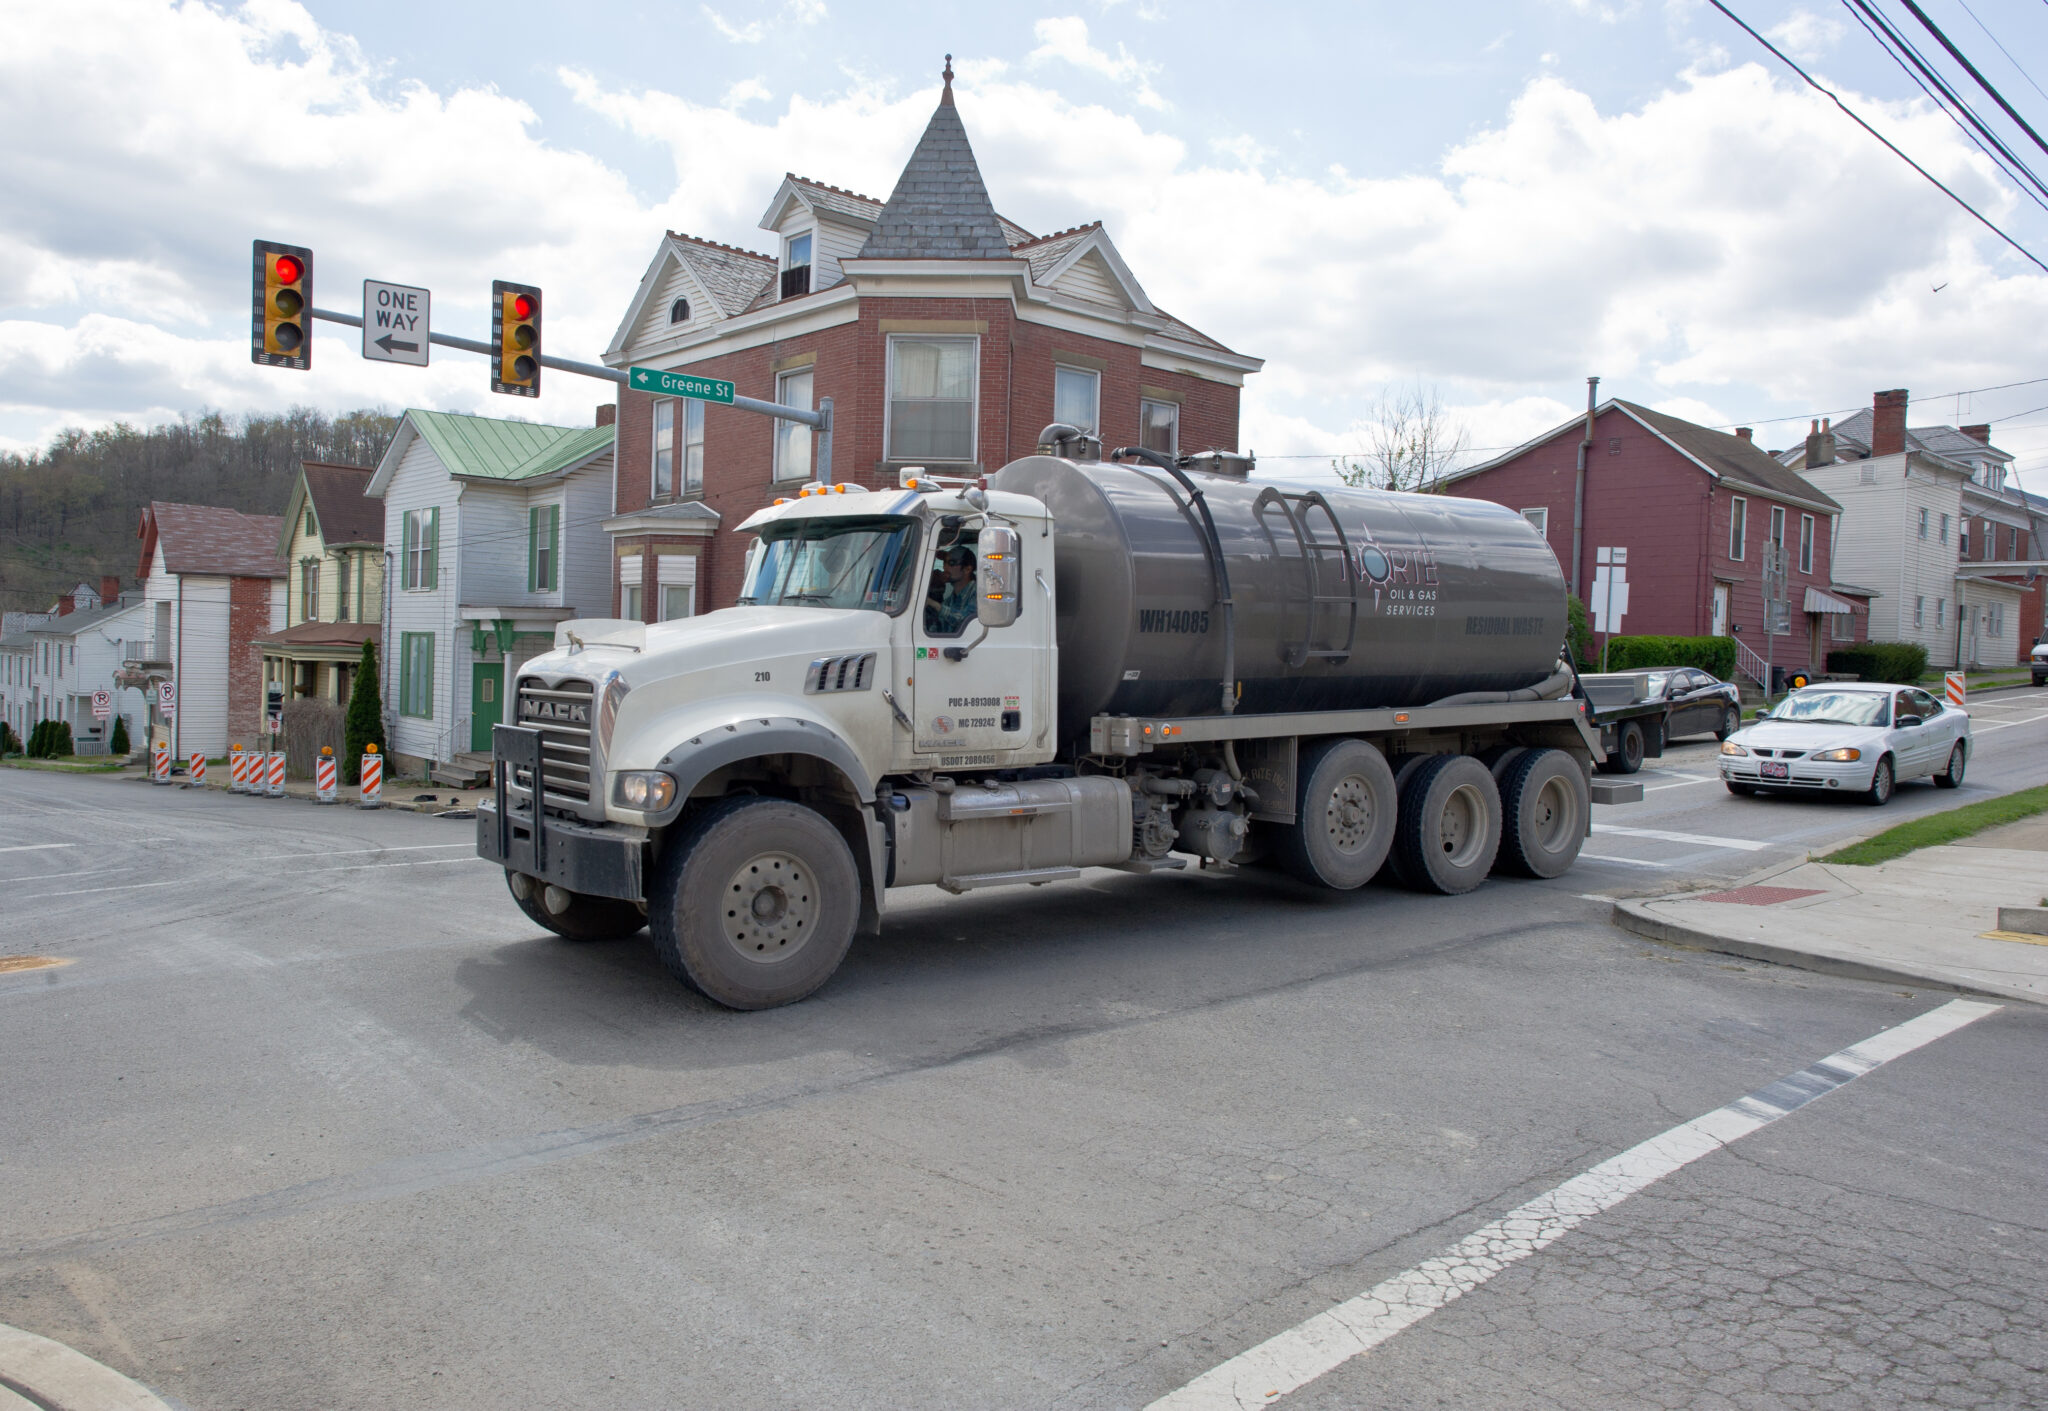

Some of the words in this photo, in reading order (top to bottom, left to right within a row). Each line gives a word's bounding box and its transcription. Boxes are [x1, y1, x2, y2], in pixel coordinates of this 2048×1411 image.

[378, 289, 418, 311] ONE
[376, 310, 419, 331] WAY
[661, 374, 711, 394] Greene
[716, 383, 729, 398] St
[1340, 543, 1440, 586] NORTE
[1390, 589, 1406, 600] OIL
[1408, 590, 1415, 600] &
[1417, 590, 1437, 600] GAS
[1386, 605, 1436, 616] SERVICES
[1139, 609, 1209, 634] WH14085
[1465, 616, 1511, 635] RESIDUAL
[1512, 616, 1544, 636] WASTE
[754, 671, 771, 682] 210
[523, 700, 586, 721] MACK
[948, 697, 963, 707] PUC
[958, 718, 970, 728] MC
[941, 756, 963, 766] USDOT
